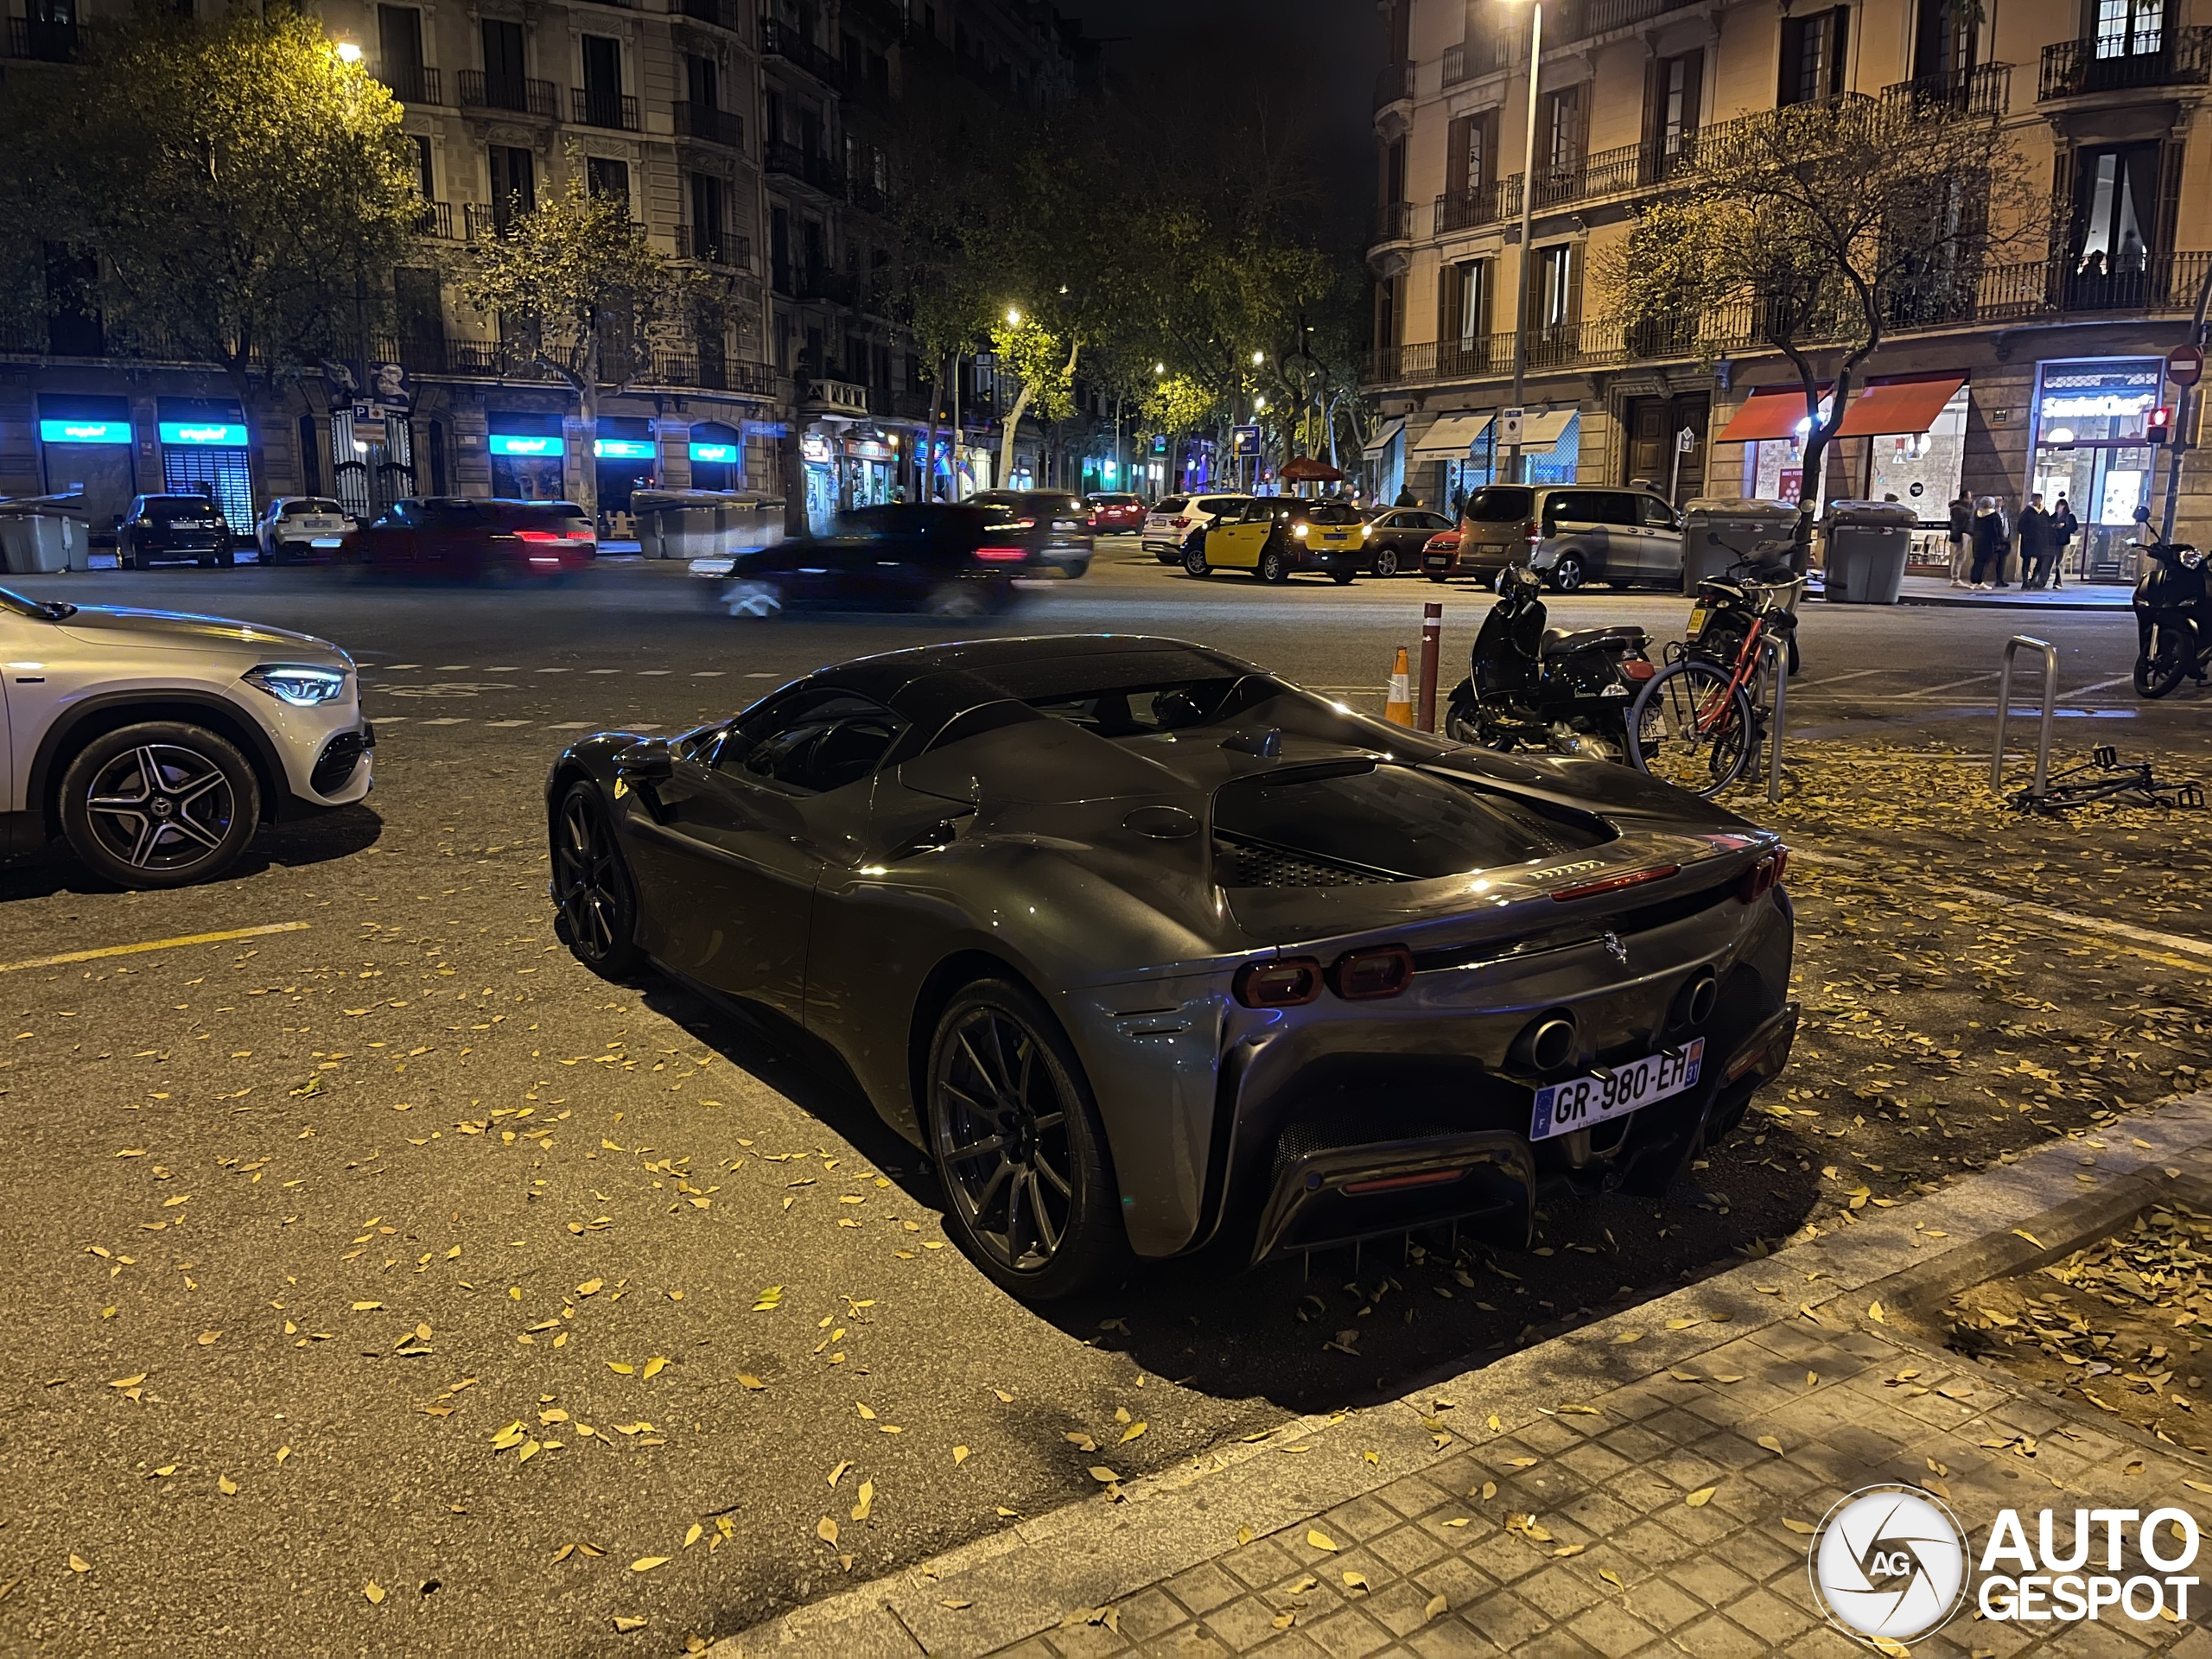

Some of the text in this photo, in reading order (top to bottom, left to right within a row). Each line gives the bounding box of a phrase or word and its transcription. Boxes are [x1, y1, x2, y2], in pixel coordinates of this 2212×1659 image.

[357, 407, 365, 416] P
[1155, 435, 1165, 448] P
[1574, 687, 1598, 698] Vespa
[1686, 1064, 1699, 1083] 31
[1554, 1047, 1688, 1125] GR-980-EH
[1538, 1118, 1545, 1130] F
